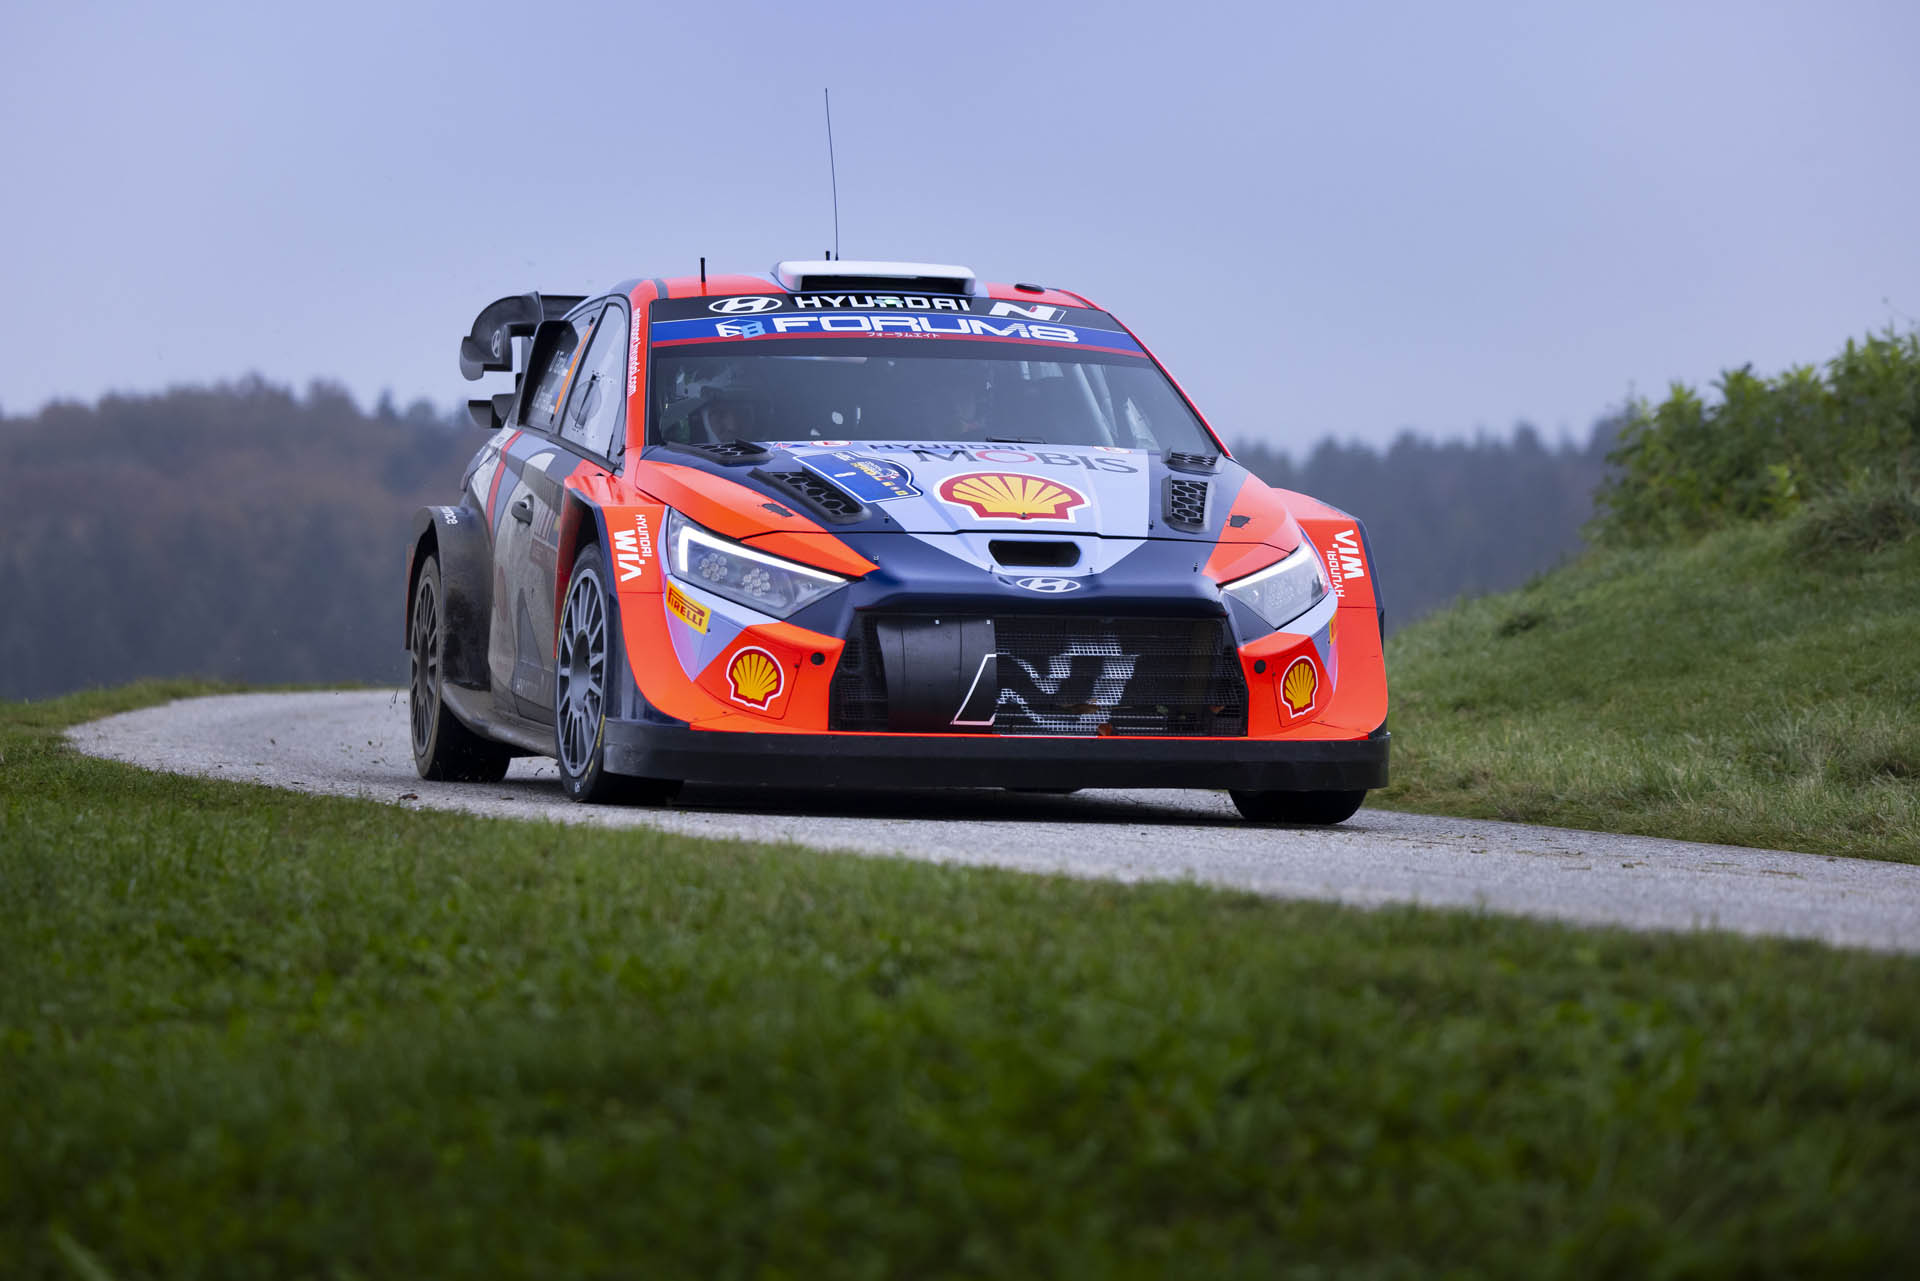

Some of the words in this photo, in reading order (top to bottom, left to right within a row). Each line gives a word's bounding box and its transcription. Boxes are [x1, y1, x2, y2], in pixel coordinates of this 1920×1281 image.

[795, 295, 971, 312] HYUNDAI
[772, 316, 1079, 343] FORUM8
[868, 443, 1027, 452] HYUNDAI
[912, 449, 1139, 474] MOBIS
[635, 514, 652, 557] HYUNDAI
[1326, 550, 1345, 597] HYUNDAI
[667, 587, 706, 627] PIRELLI
